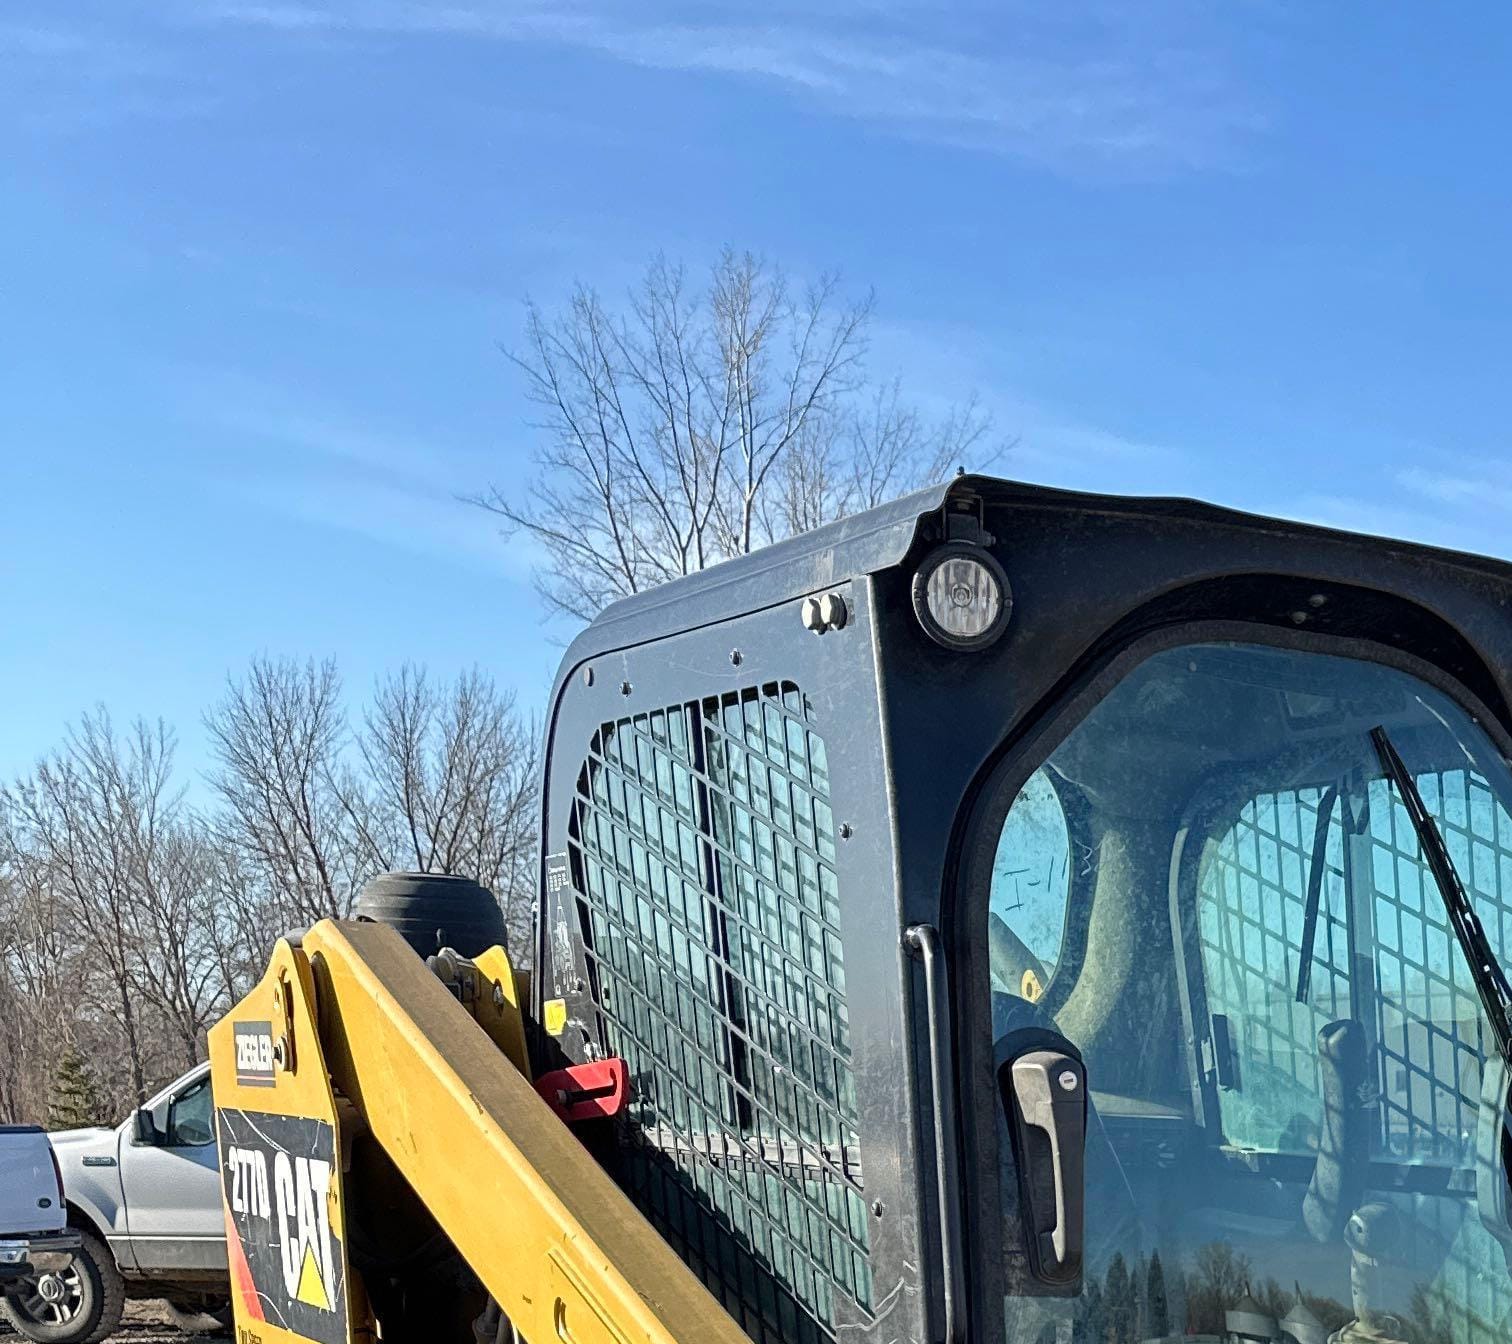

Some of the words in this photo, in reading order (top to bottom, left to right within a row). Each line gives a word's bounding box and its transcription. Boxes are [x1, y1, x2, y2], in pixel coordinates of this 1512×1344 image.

[236, 1034, 273, 1071] ZIEGLER
[229, 1146, 271, 1219] 277D
[275, 1151, 336, 1313] CAT
